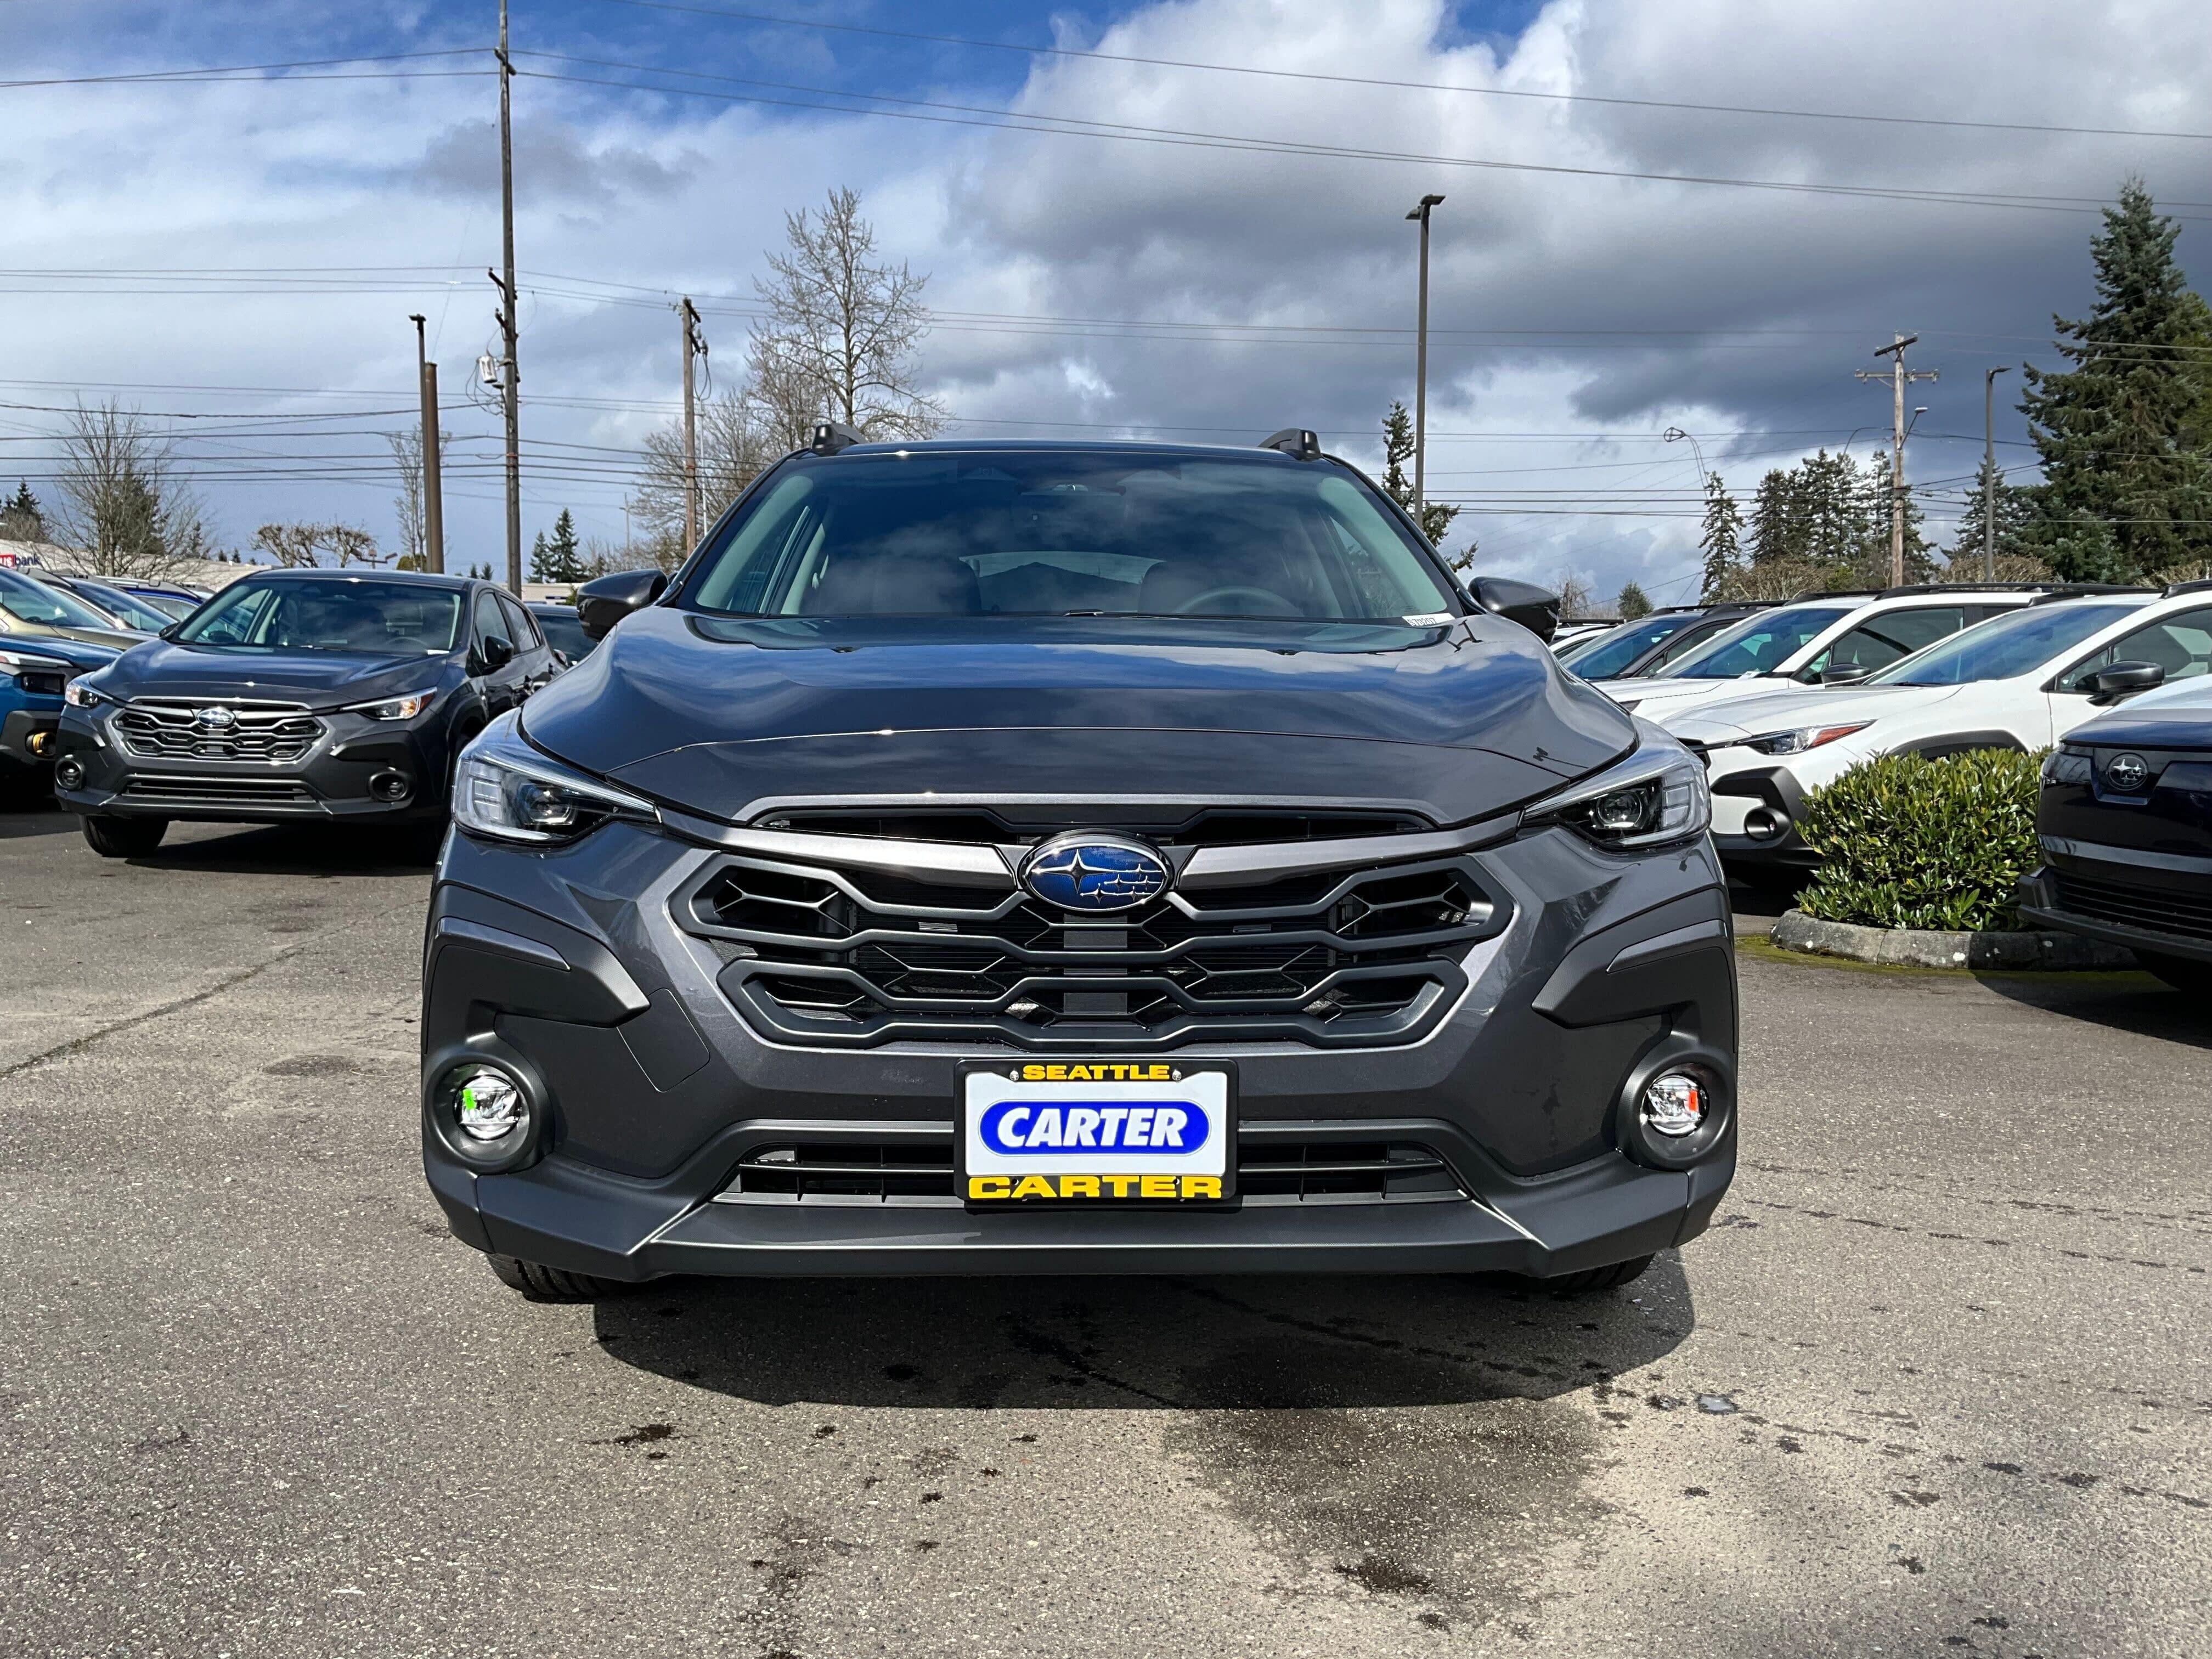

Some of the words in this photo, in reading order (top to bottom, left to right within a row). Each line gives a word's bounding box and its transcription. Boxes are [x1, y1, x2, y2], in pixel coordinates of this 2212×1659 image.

[1023, 1065, 1170, 1080] SEATTLE
[997, 1107, 1188, 1147] CARTER
[969, 1175, 1222, 1199] CARTER
